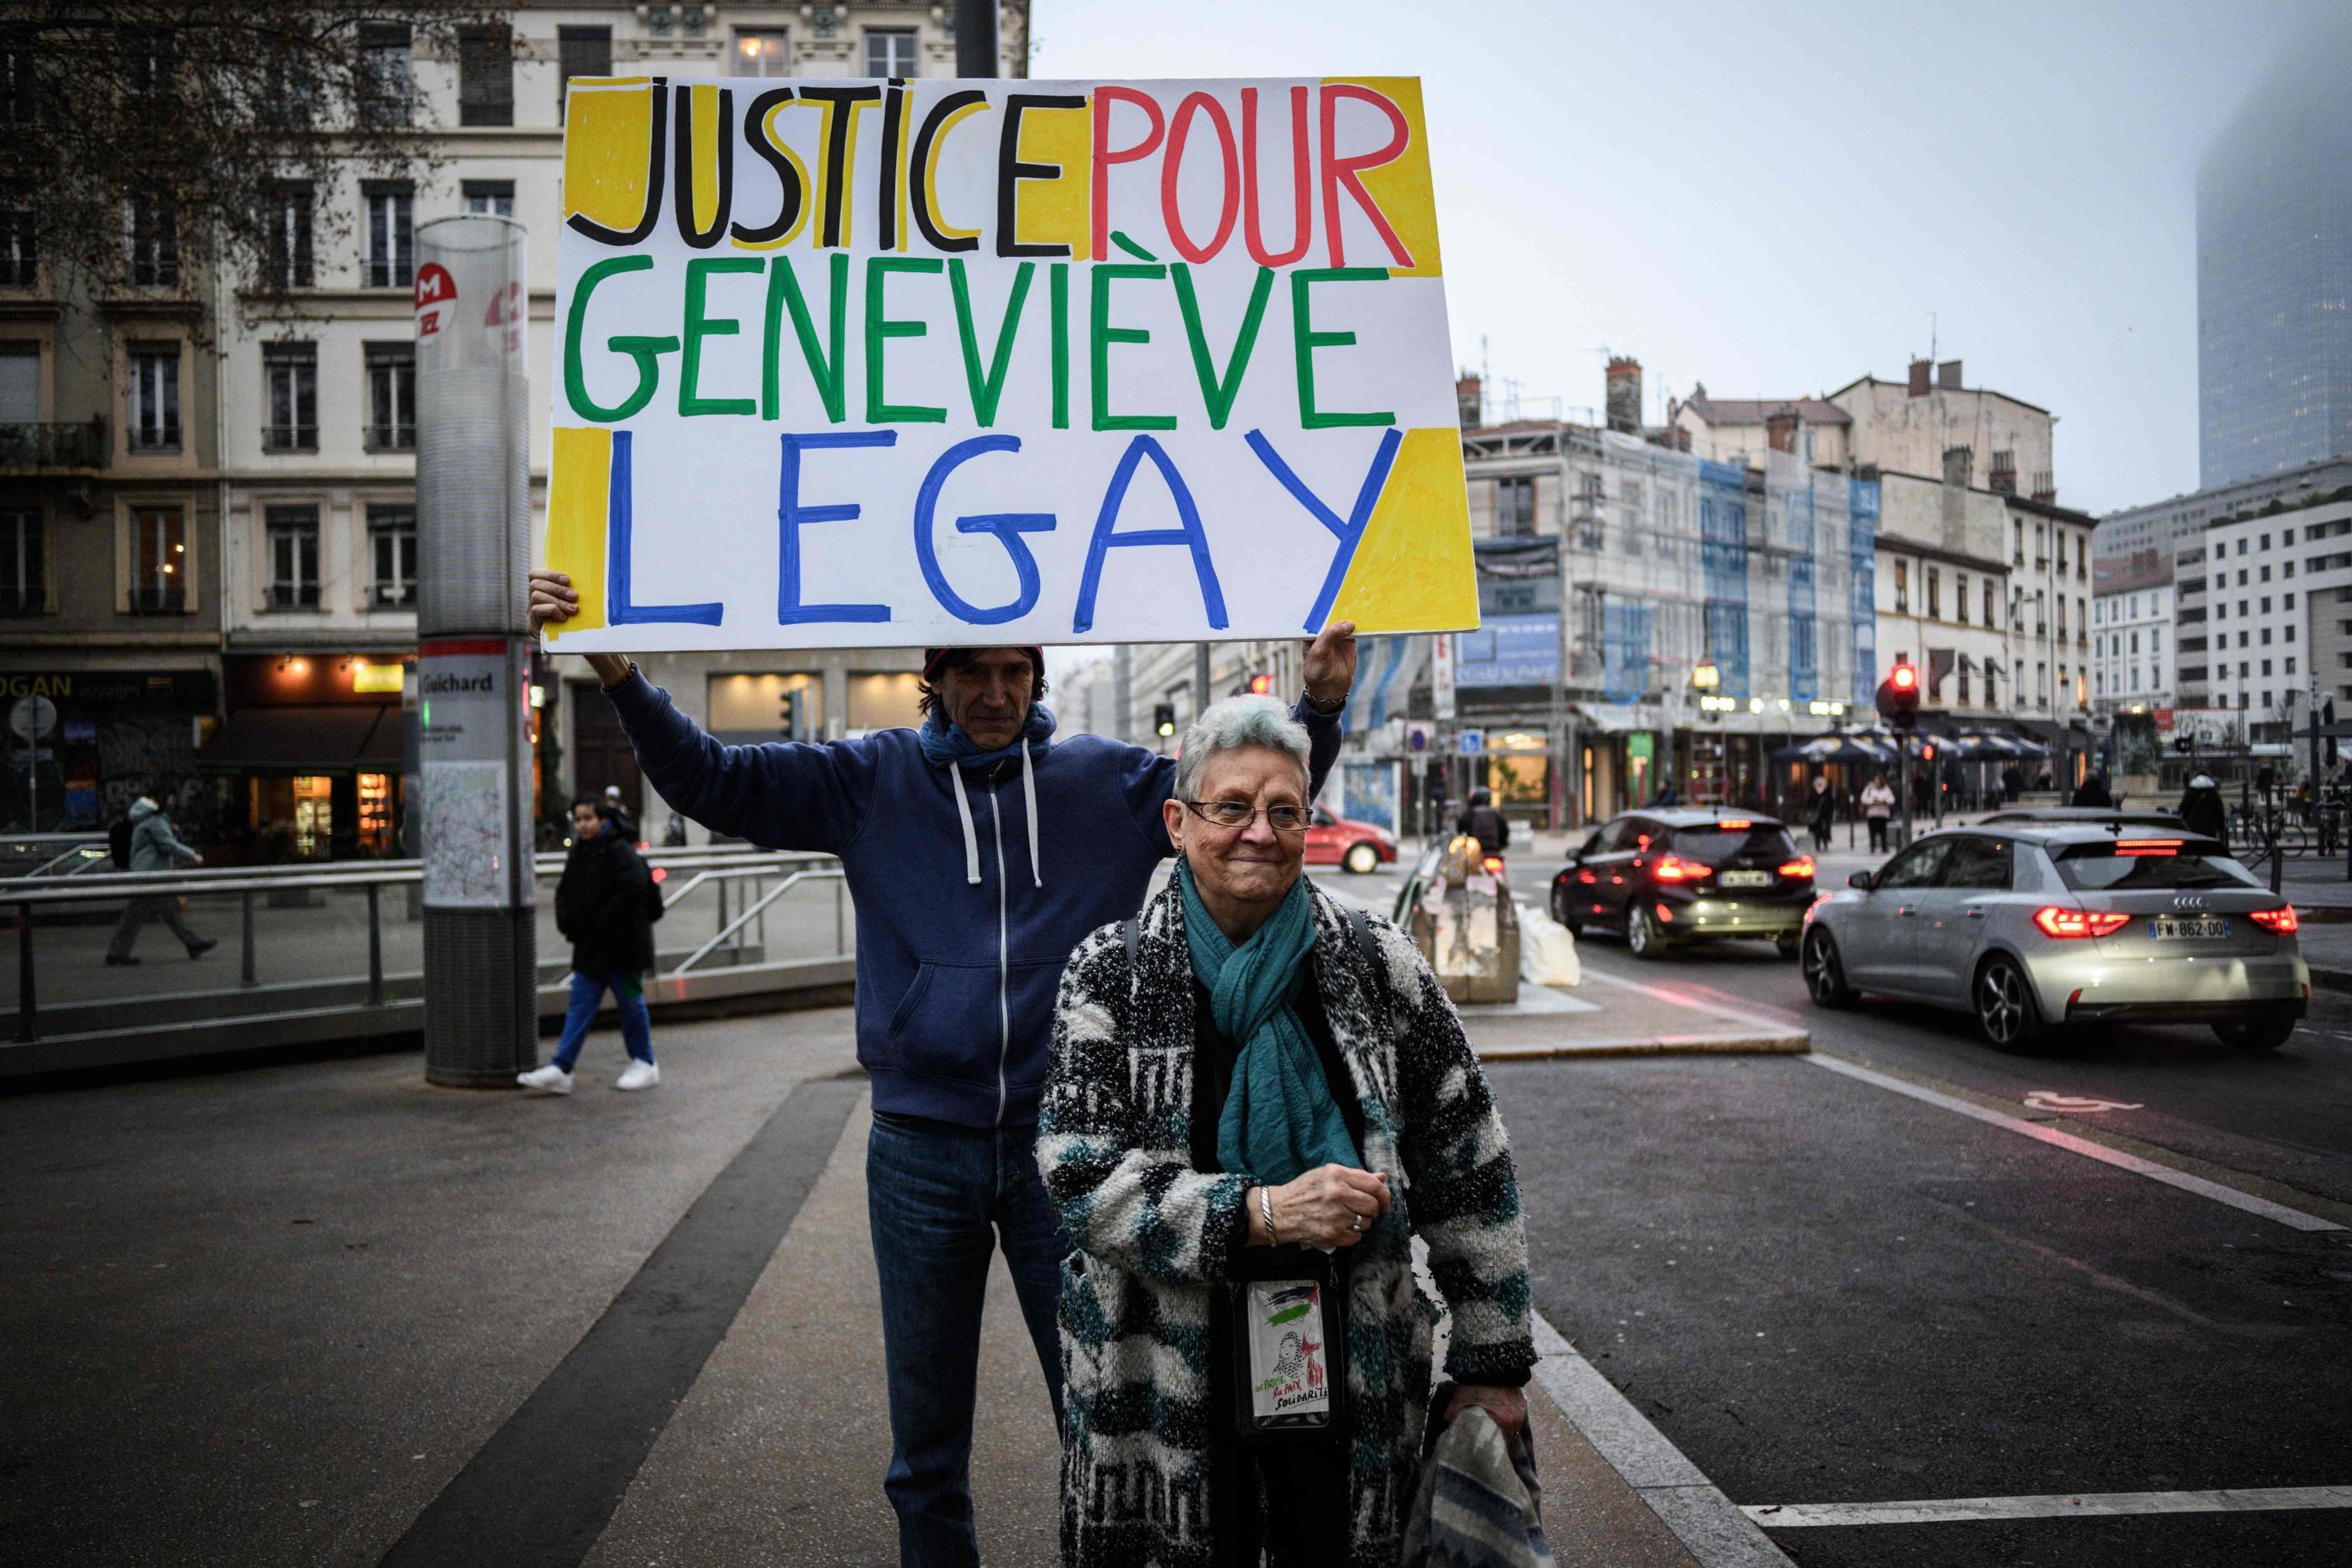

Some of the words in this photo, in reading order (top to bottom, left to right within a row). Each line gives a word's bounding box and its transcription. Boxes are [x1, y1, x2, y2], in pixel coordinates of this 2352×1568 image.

[1092, 85, 1415, 269] POUR
[418, 273, 440, 302] M
[564, 231, 1396, 431] GENEVIÈVE
[607, 428, 1404, 635] LEGAY
[423, 674, 493, 693] Guichard
